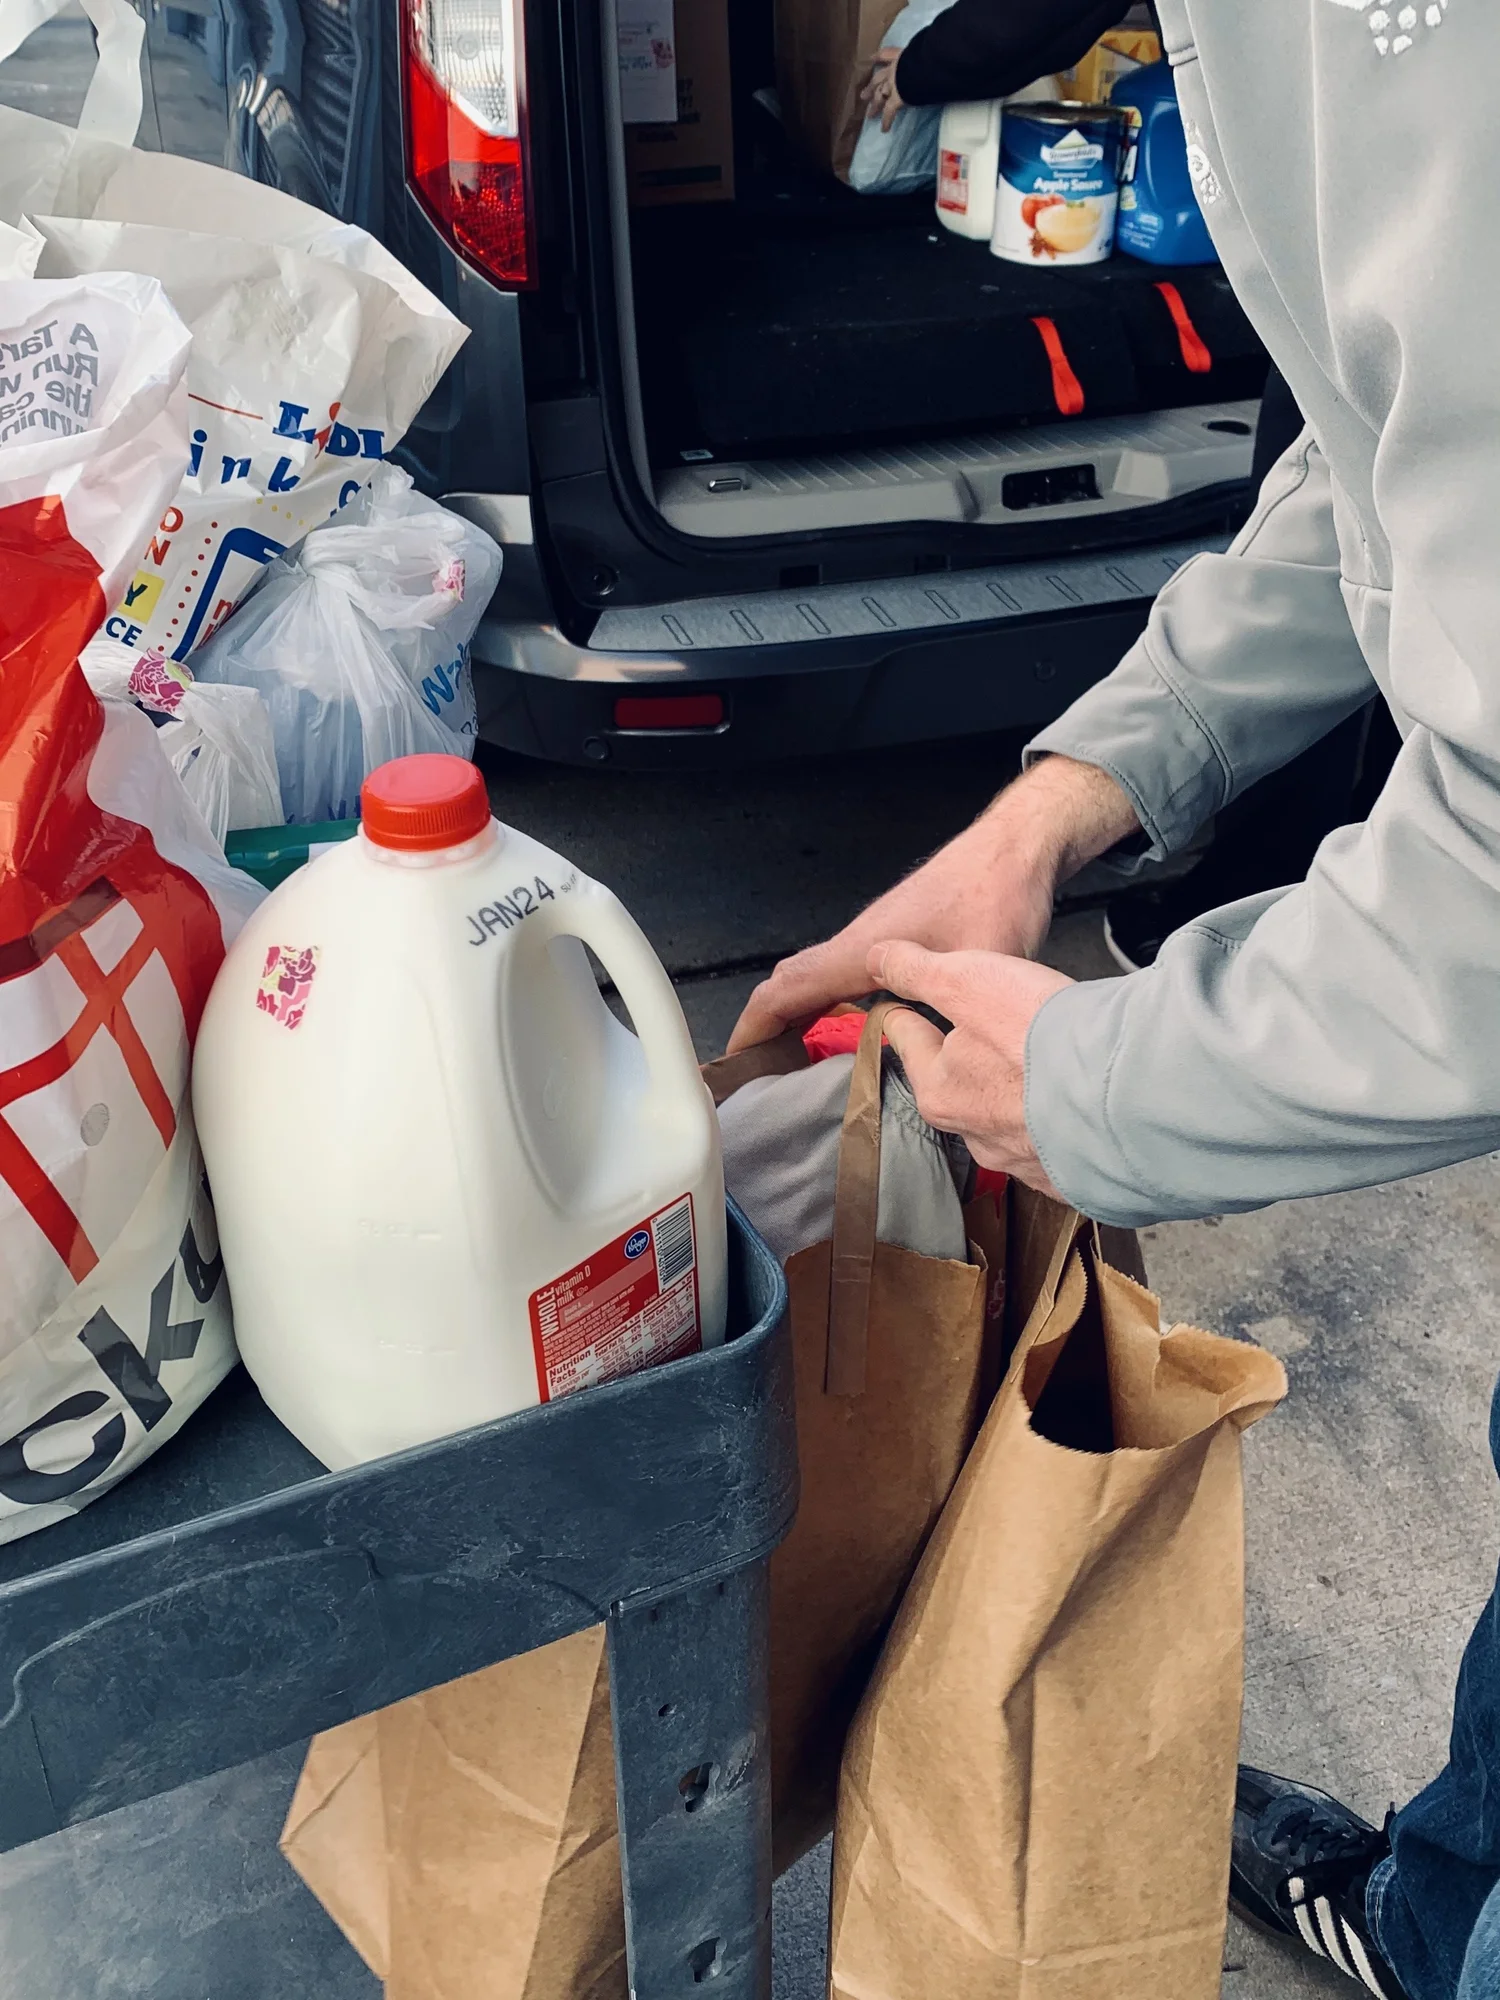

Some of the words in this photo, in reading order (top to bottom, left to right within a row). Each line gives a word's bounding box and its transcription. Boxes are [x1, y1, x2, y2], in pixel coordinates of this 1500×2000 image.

[1034, 177, 1070, 193] Apple
[555, 1271, 584, 1296] vitamin
[585, 1265, 592, 1278] D
[557, 1290, 575, 1308] milk
[537, 1287, 559, 1341] WHOLE
[609, 1341, 618, 1352] Fat
[549, 1350, 591, 1378] Nutrition
[550, 1368, 577, 1386] Facts
